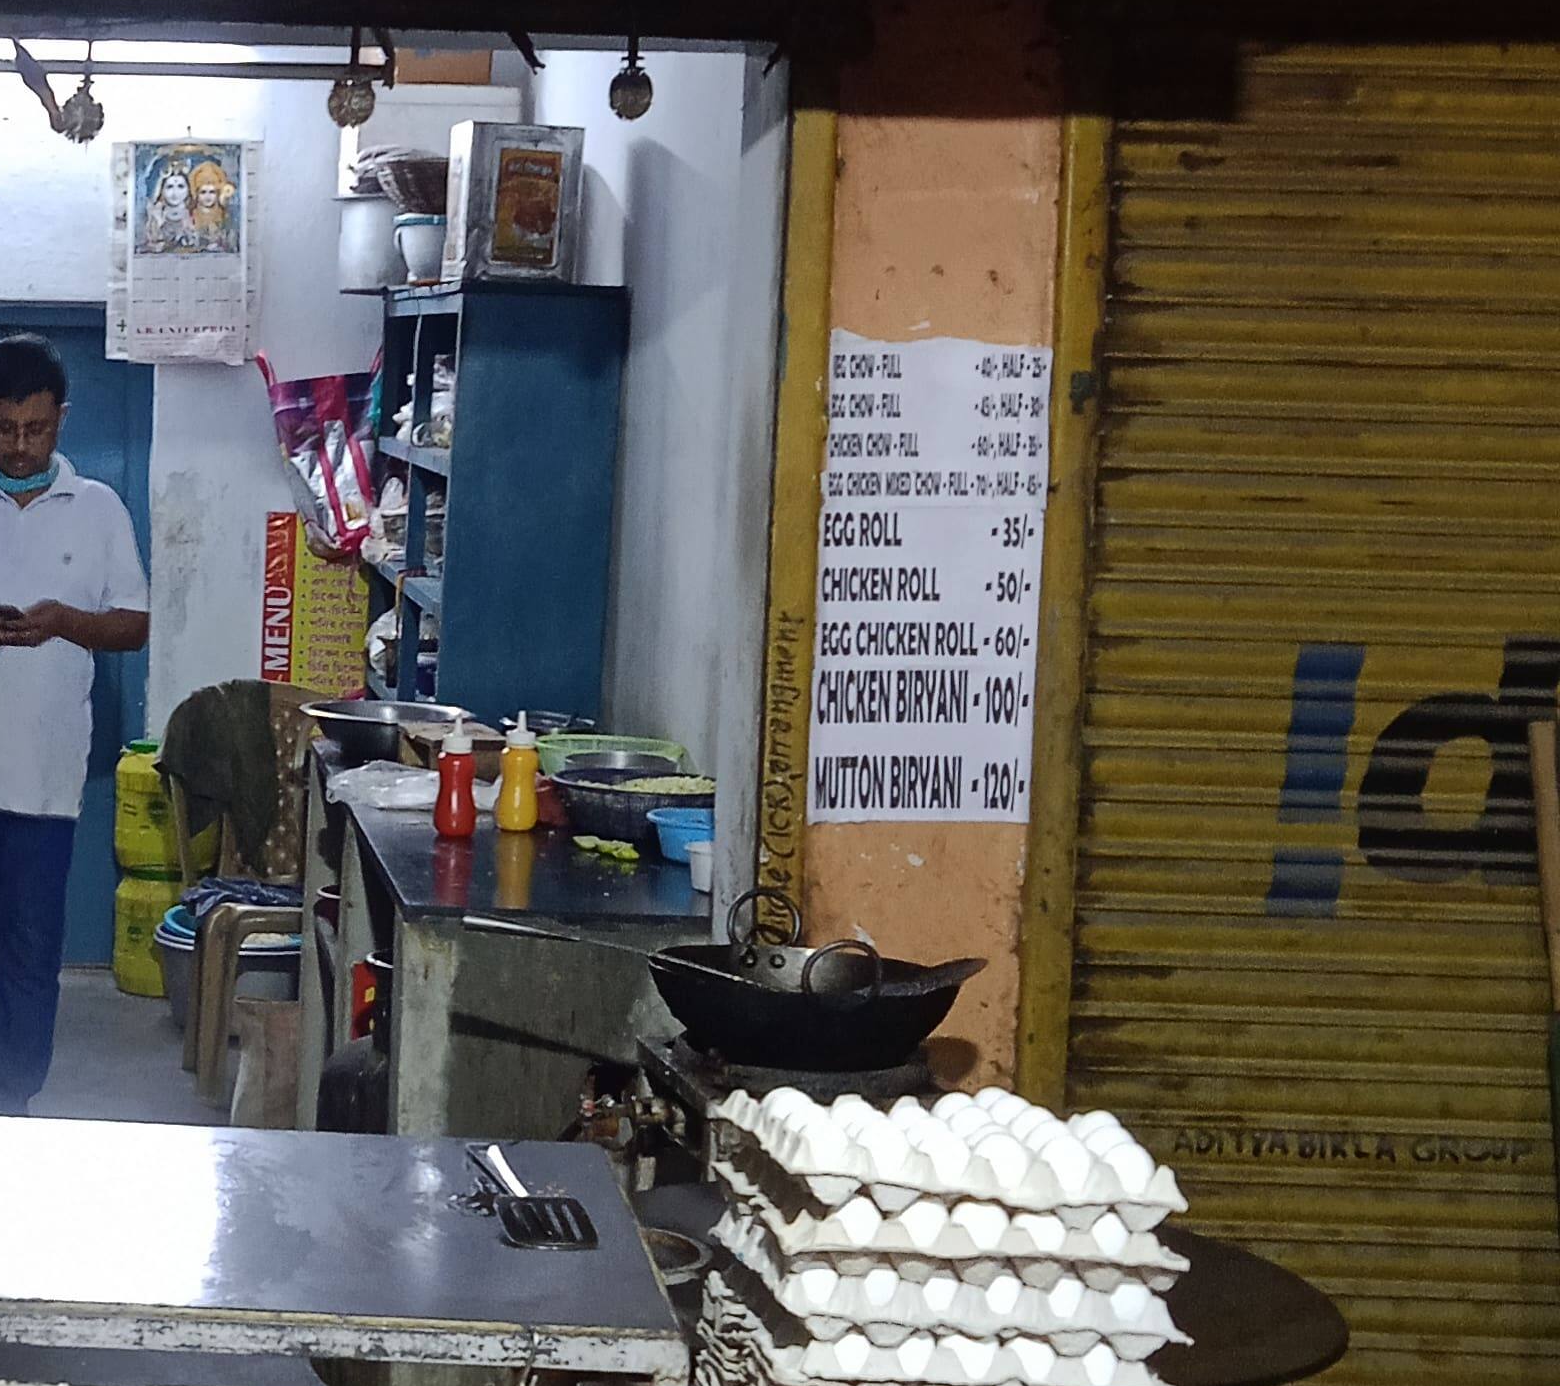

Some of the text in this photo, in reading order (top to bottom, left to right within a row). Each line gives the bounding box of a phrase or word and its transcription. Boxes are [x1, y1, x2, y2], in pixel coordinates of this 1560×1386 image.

[823, 512, 855, 547] EGG
[859, 512, 902, 547] ROLL
[821, 567, 892, 602] CHICKEN
[897, 567, 940, 602] ROLL
[263, 586, 292, 671] MENU
[821, 622, 852, 656] EGG
[856, 622, 930, 656] CHICKEN
[935, 622, 978, 656] ROLL
[817, 669, 890, 725] CHICKEN
[895, 669, 969, 724] BIRYANI
[815, 755, 885, 809] MUTTON
[891, 755, 963, 809] BIRYANI
[1174, 1128, 1533, 1163] ADITYA BIRLA GROUP
